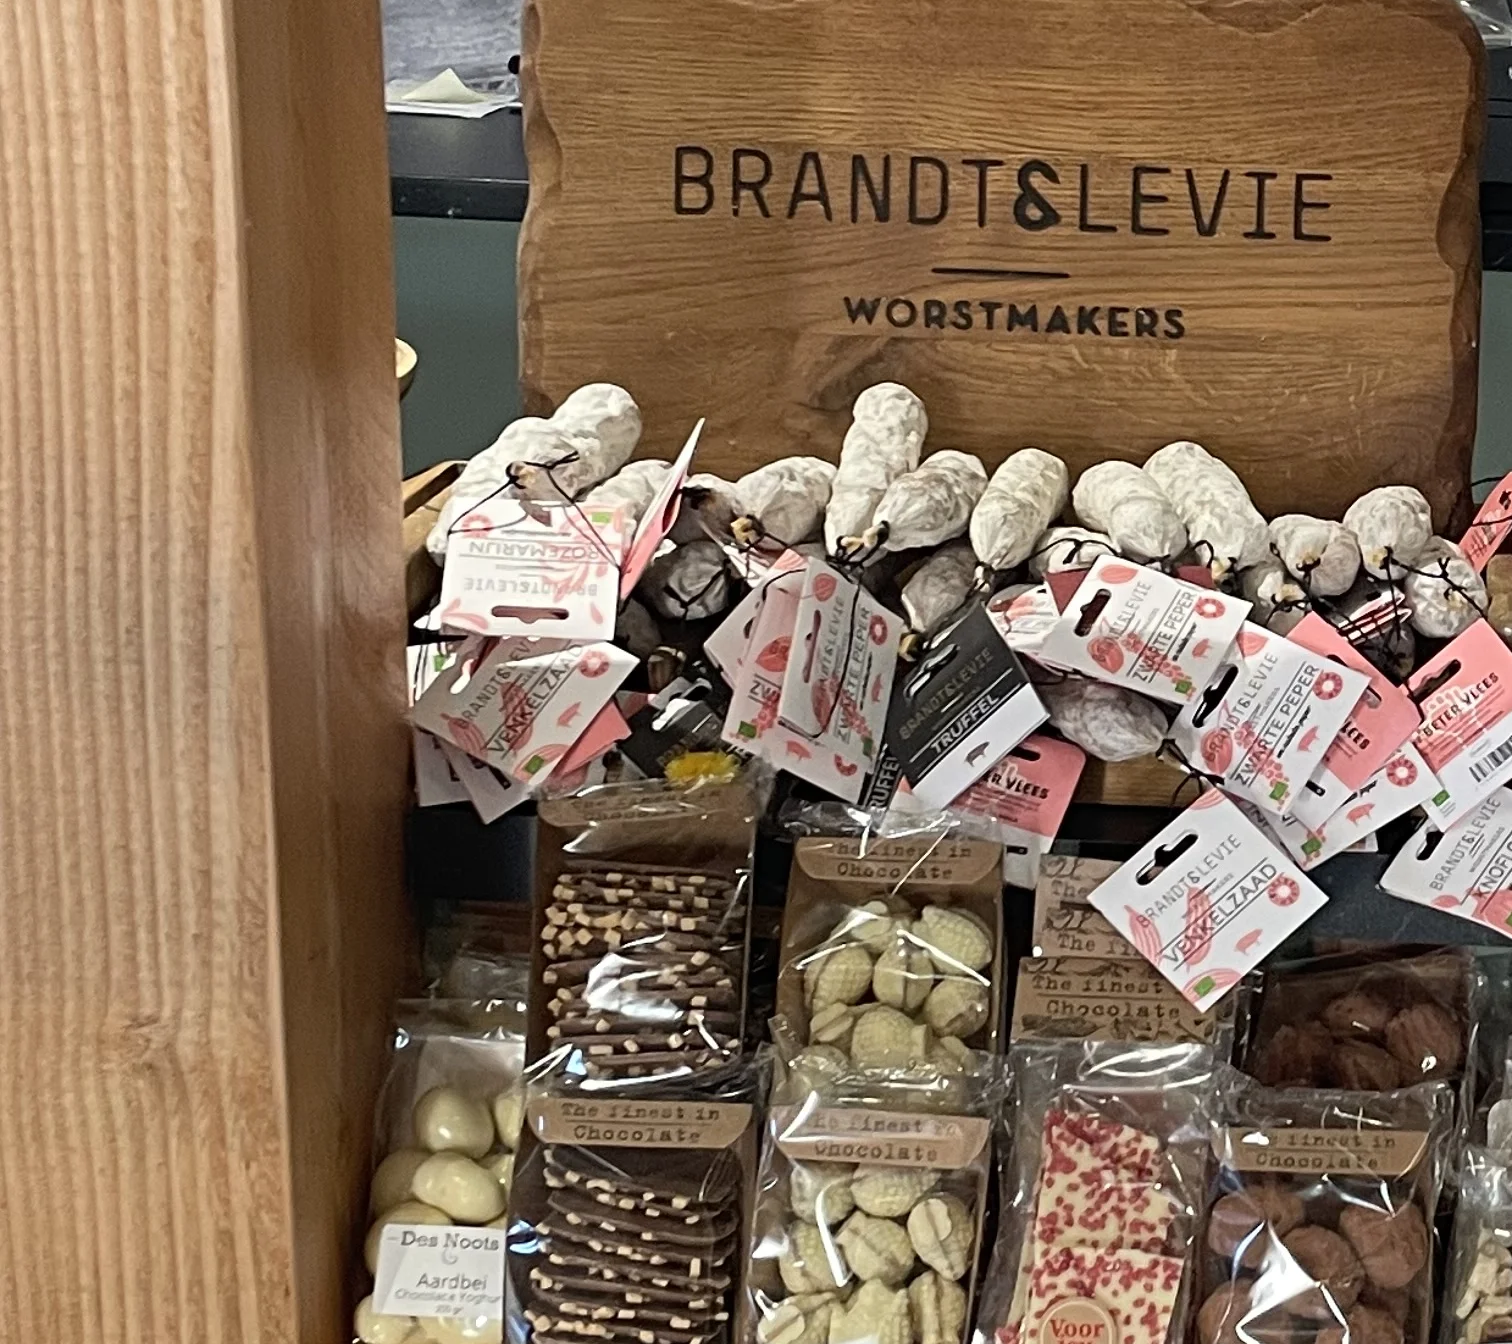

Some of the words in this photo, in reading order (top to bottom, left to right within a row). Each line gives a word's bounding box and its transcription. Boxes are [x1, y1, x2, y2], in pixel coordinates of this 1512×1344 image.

[674, 145, 1332, 241] BRANDT&LEVIE
[843, 295, 1184, 340] WORSTMAKERS
[931, 694, 1000, 754] TRUFFEL
[1235, 716, 1285, 787] ZWARTE
[1286, 662, 1321, 718] PEPER
[1162, 862, 1278, 965] VENKELZAAD
[1032, 974, 1072, 990] The
[1046, 999, 1180, 1019] Chocolate
[573, 1125, 702, 1145] Chocolate
[417, 1273, 487, 1290] Aardbei
[1050, 1319, 1104, 1337] Voor
